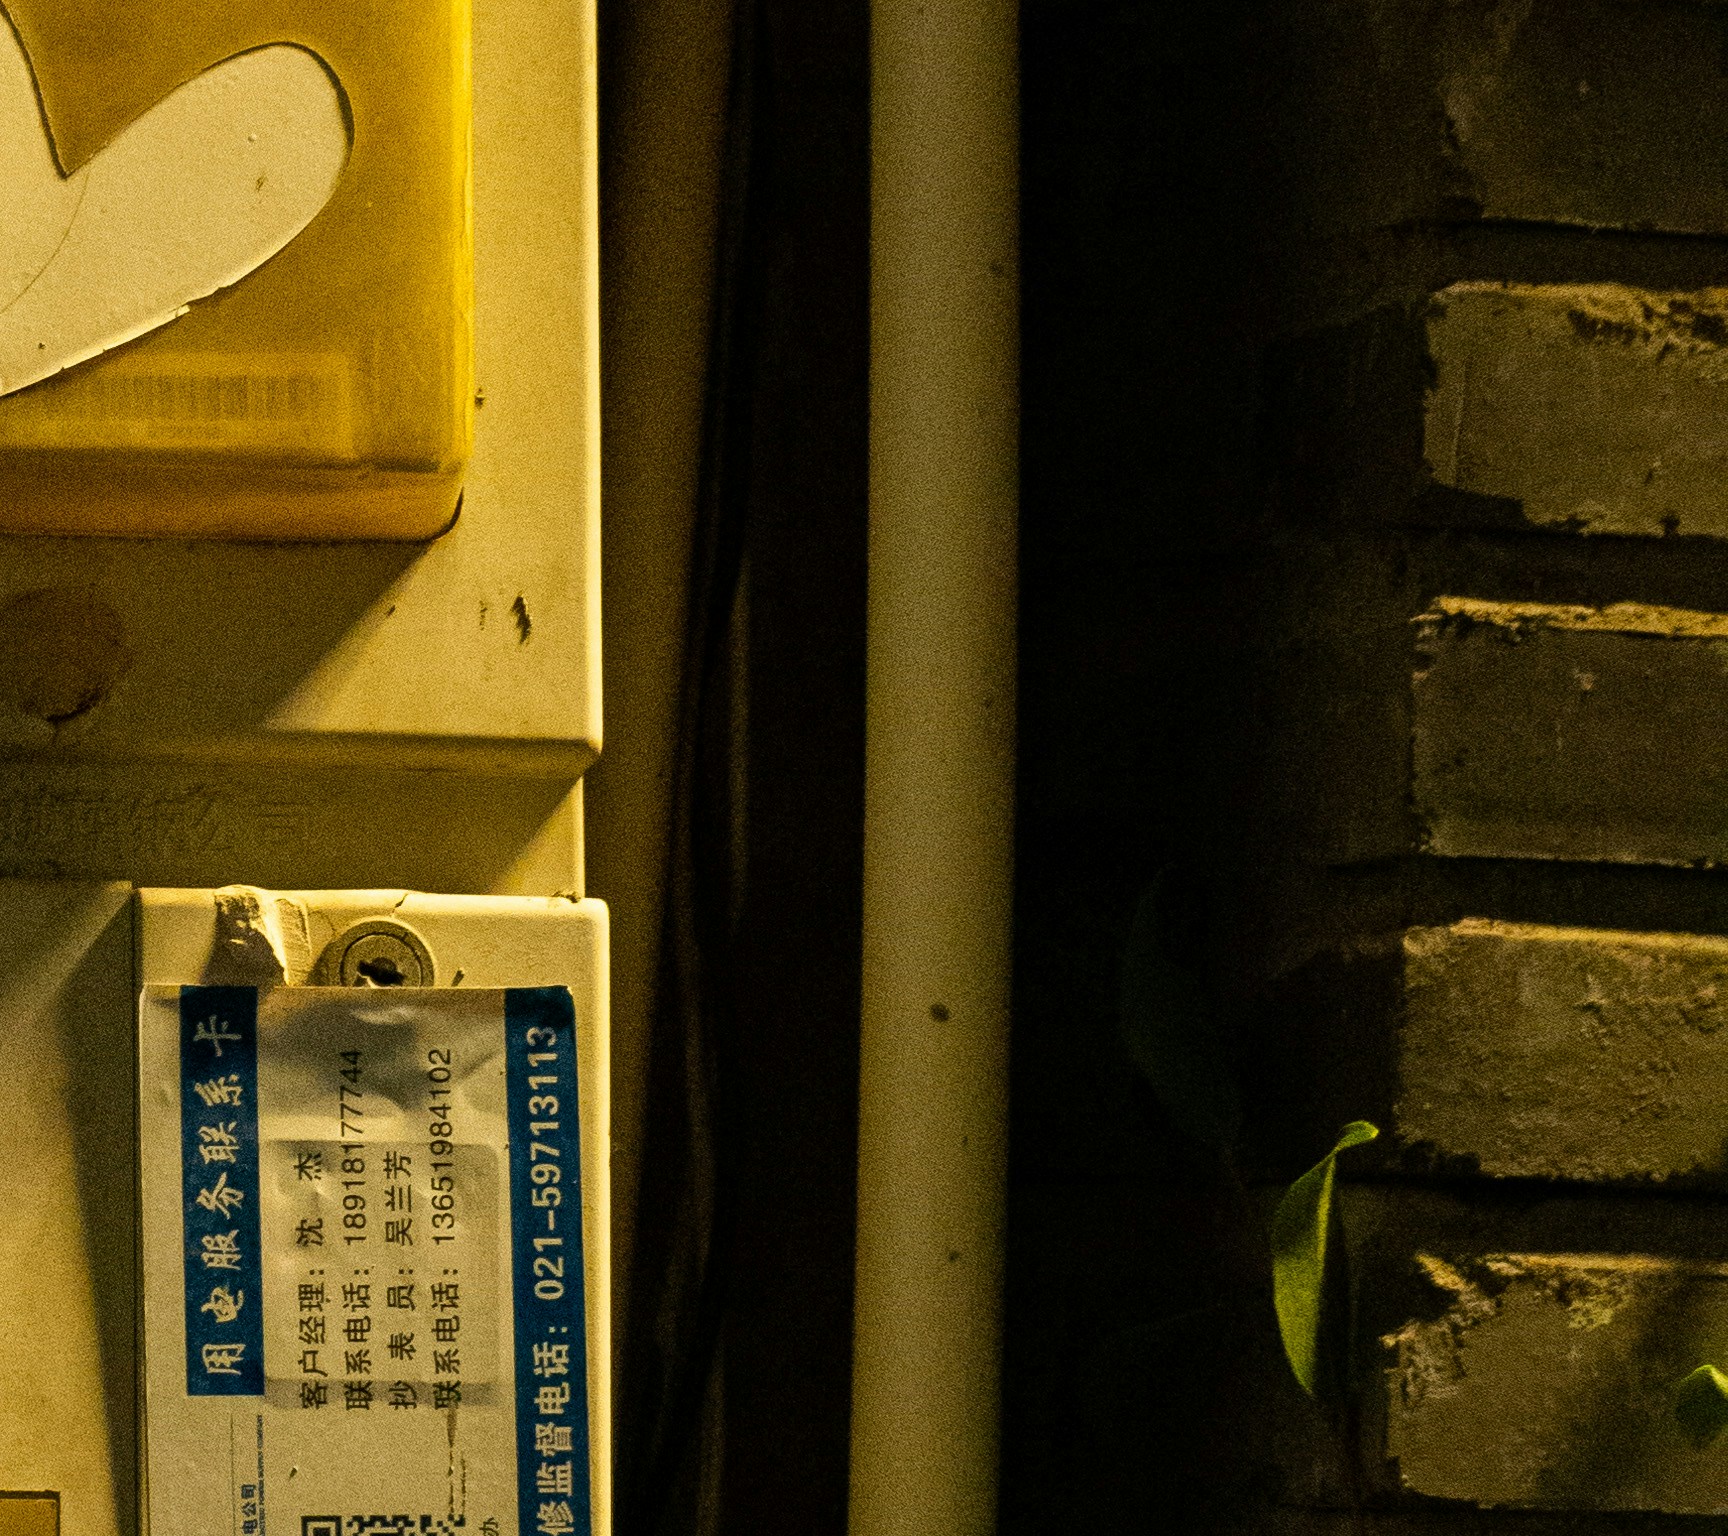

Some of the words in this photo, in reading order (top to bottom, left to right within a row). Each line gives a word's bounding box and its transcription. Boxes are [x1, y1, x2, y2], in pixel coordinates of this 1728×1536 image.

[192, 1014, 247, 1376] 用电服务联系卡
[340, 1049, 367, 1247] 18918177744
[383, 1150, 414, 1248] 吴兰芳
[427, 1049, 455, 1247] 13651984102
[525, 1025, 564, 1301] 021-59713113
